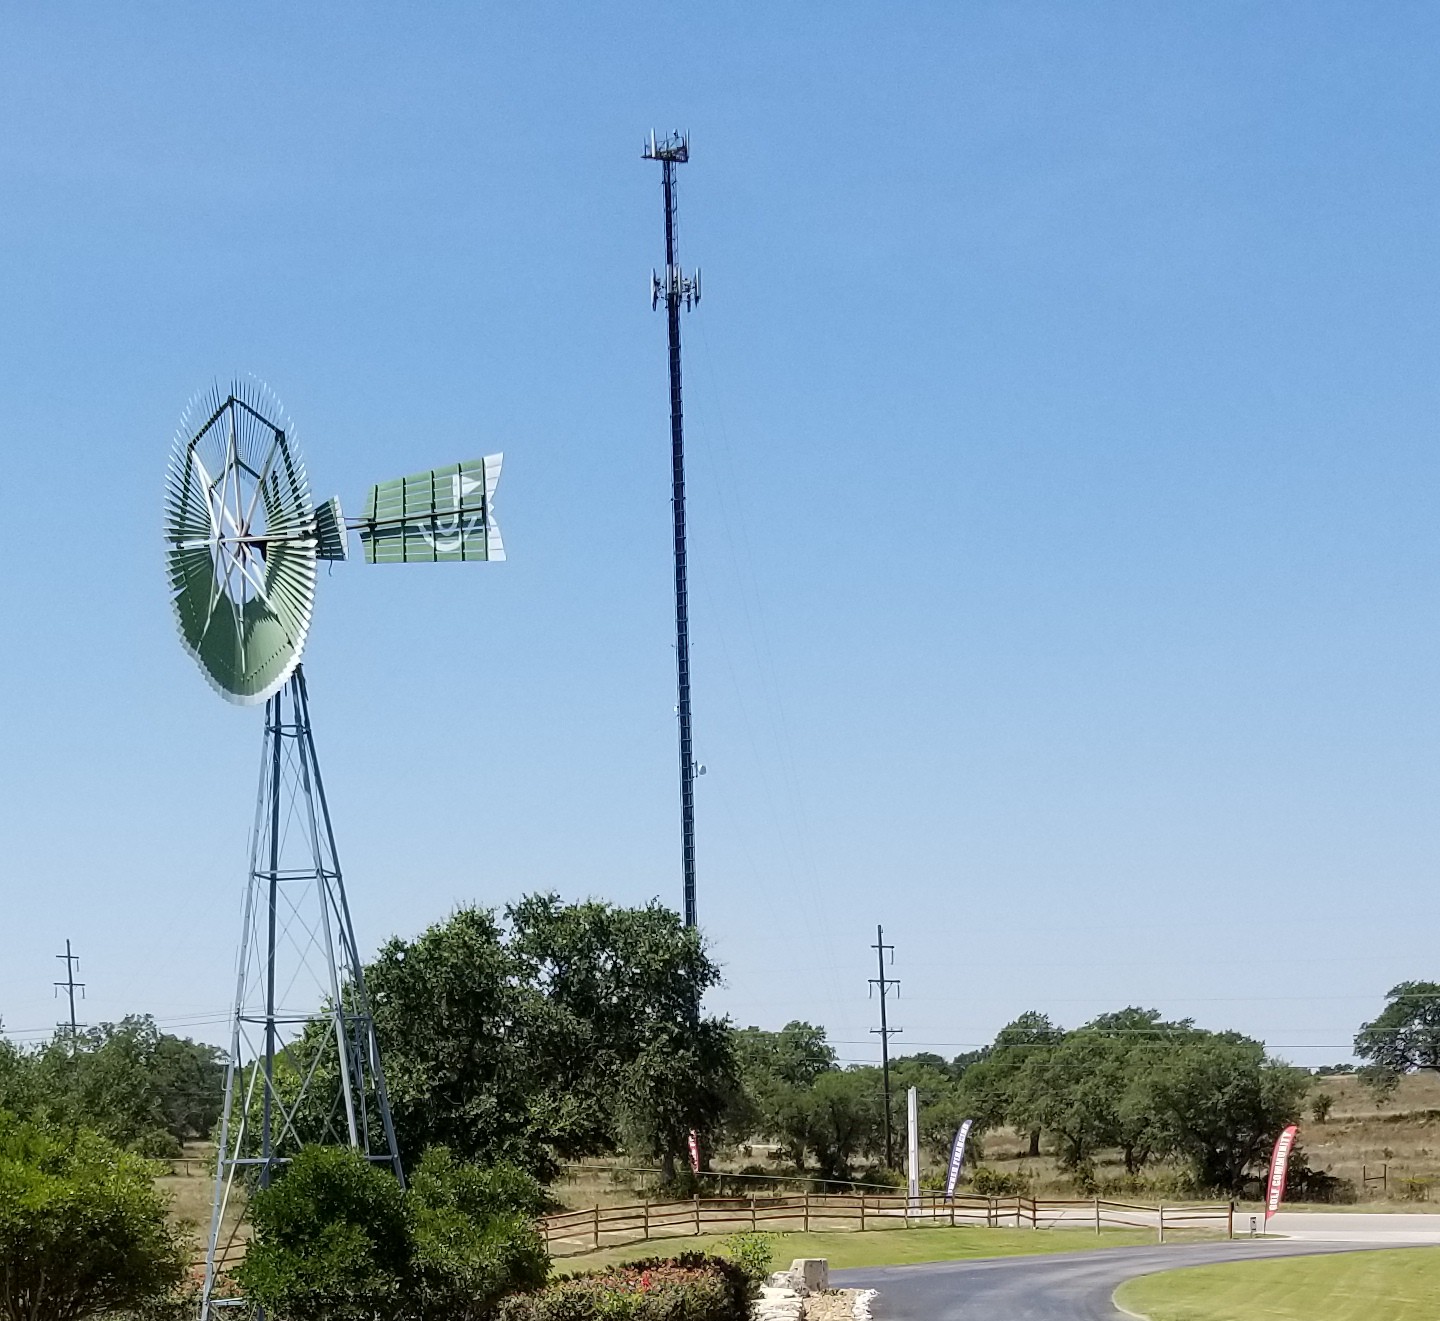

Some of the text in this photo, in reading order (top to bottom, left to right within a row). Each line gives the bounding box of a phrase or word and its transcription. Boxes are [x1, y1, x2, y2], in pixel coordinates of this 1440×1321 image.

[952, 1122, 969, 1165] FINANCING
[1268, 1131, 1292, 1211] GOLF COMMUNITY
